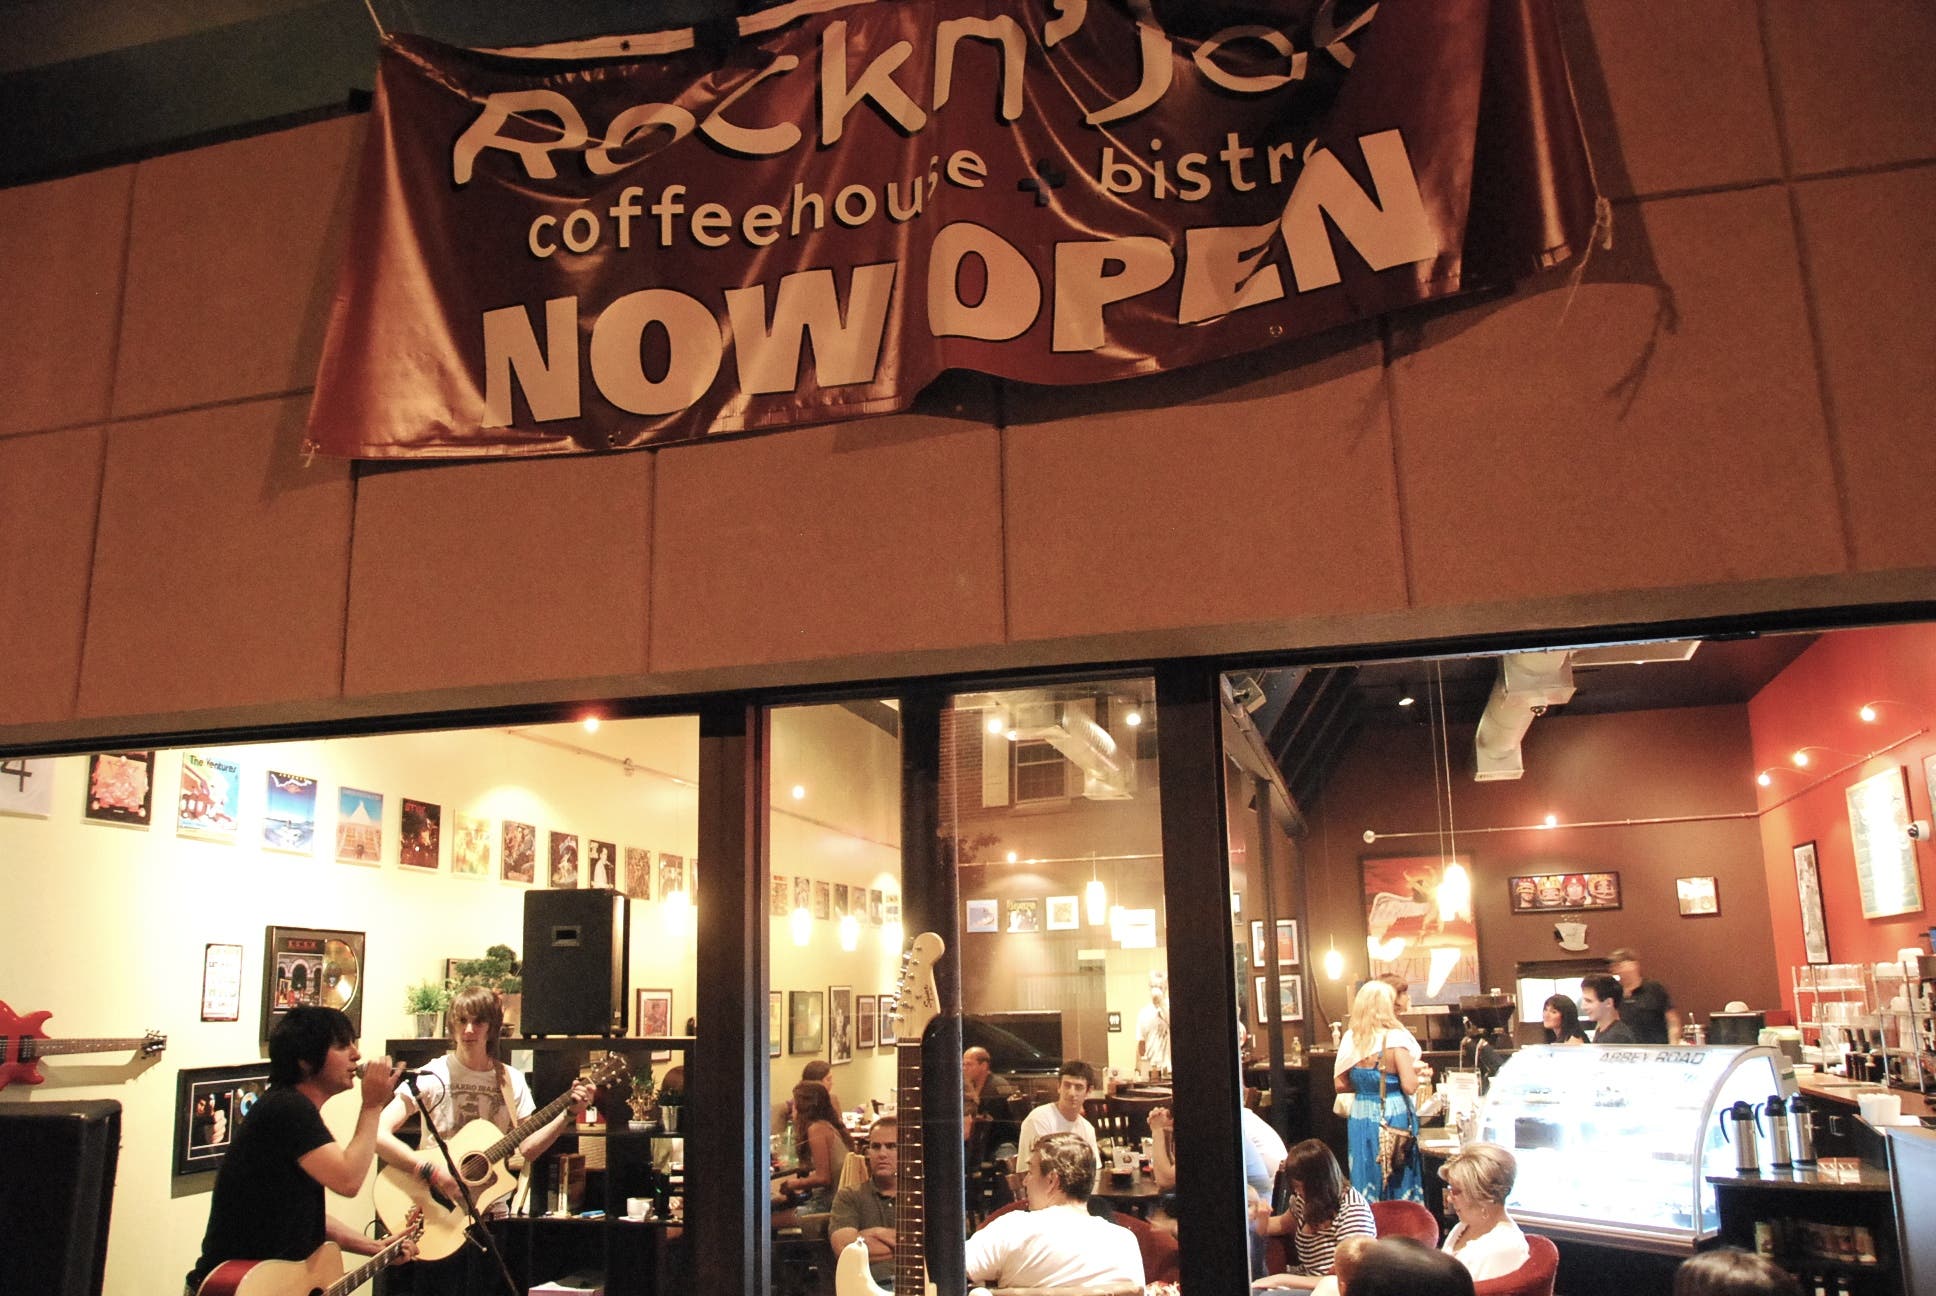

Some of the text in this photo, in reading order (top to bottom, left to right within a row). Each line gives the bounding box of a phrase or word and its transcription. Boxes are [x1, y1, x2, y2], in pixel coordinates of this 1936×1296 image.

[1100, 132, 1320, 202] bistr
[481, 128, 1438, 429] NOW OPEN
[190, 754, 204, 767] The
[1600, 1051, 1706, 1065] ABBEY ROAD
